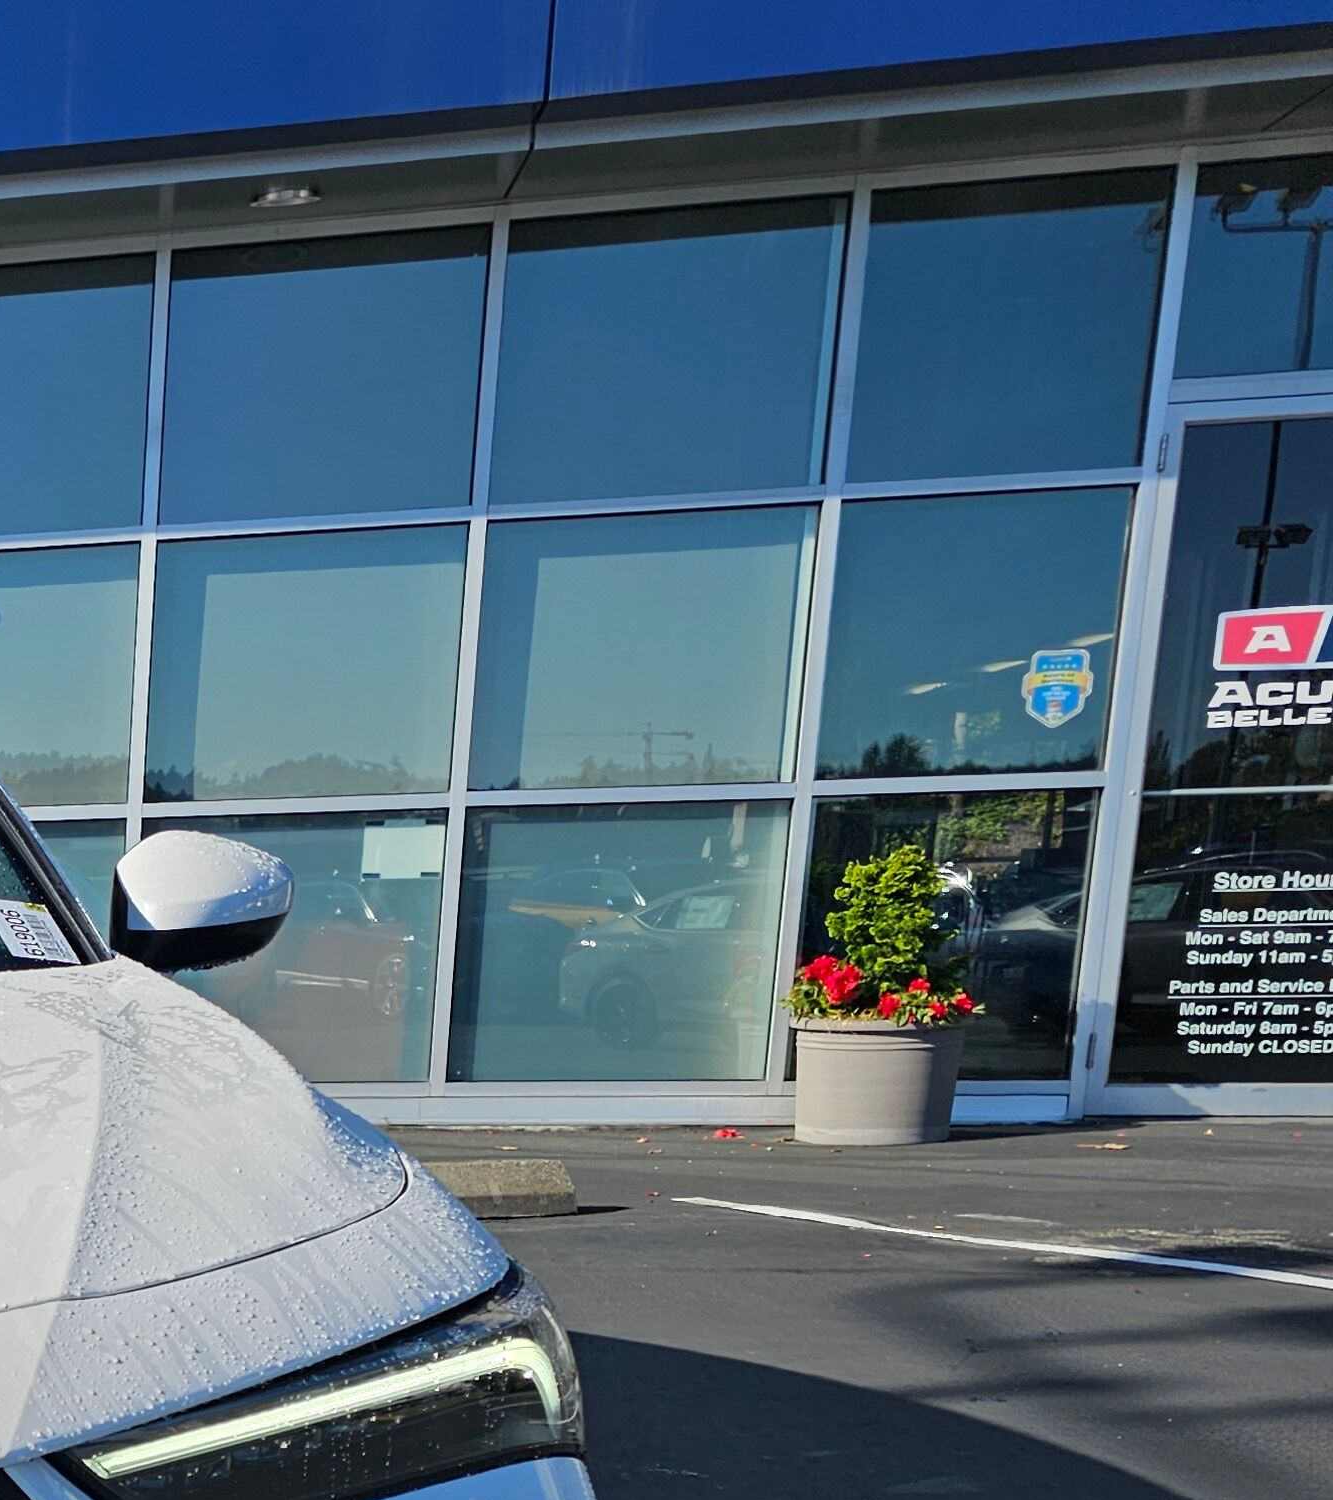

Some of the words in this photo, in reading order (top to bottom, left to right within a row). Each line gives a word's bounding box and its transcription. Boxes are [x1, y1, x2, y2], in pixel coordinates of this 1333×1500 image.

[1244, 625, 1291, 653] A
[1208, 680, 1333, 708] ACU
[1206, 707, 1333, 728] BELLE
[1213, 872, 1276, 890] Store
[1199, 908, 1249, 922] Sales
[1185, 931, 1224, 945] Mon
[1239, 930, 1270, 945] Sat
[1273, 930, 1312, 944] 9am
[1186, 950, 1253, 967] Sunday
[1258, 950, 1306, 964] 11am
[1321, 949, 1333, 966] 5
[1169, 980, 1215, 994] Parts
[1219, 979, 1253, 993] and
[1257, 978, 1325, 993] Service
[1179, 1002, 1218, 1016] Mon
[1233, 1001, 1257, 1015] Fri
[1262, 1002, 1299, 1015] 7am
[1177, 1021, 1256, 1038] Saturday
[1259, 1021, 1298, 1035] 8am
[1313, 1020, 1333, 1037] 5p
[1187, 1040, 1254, 1057] Sunday
[1258, 1039, 1333, 1054] CLOSED
